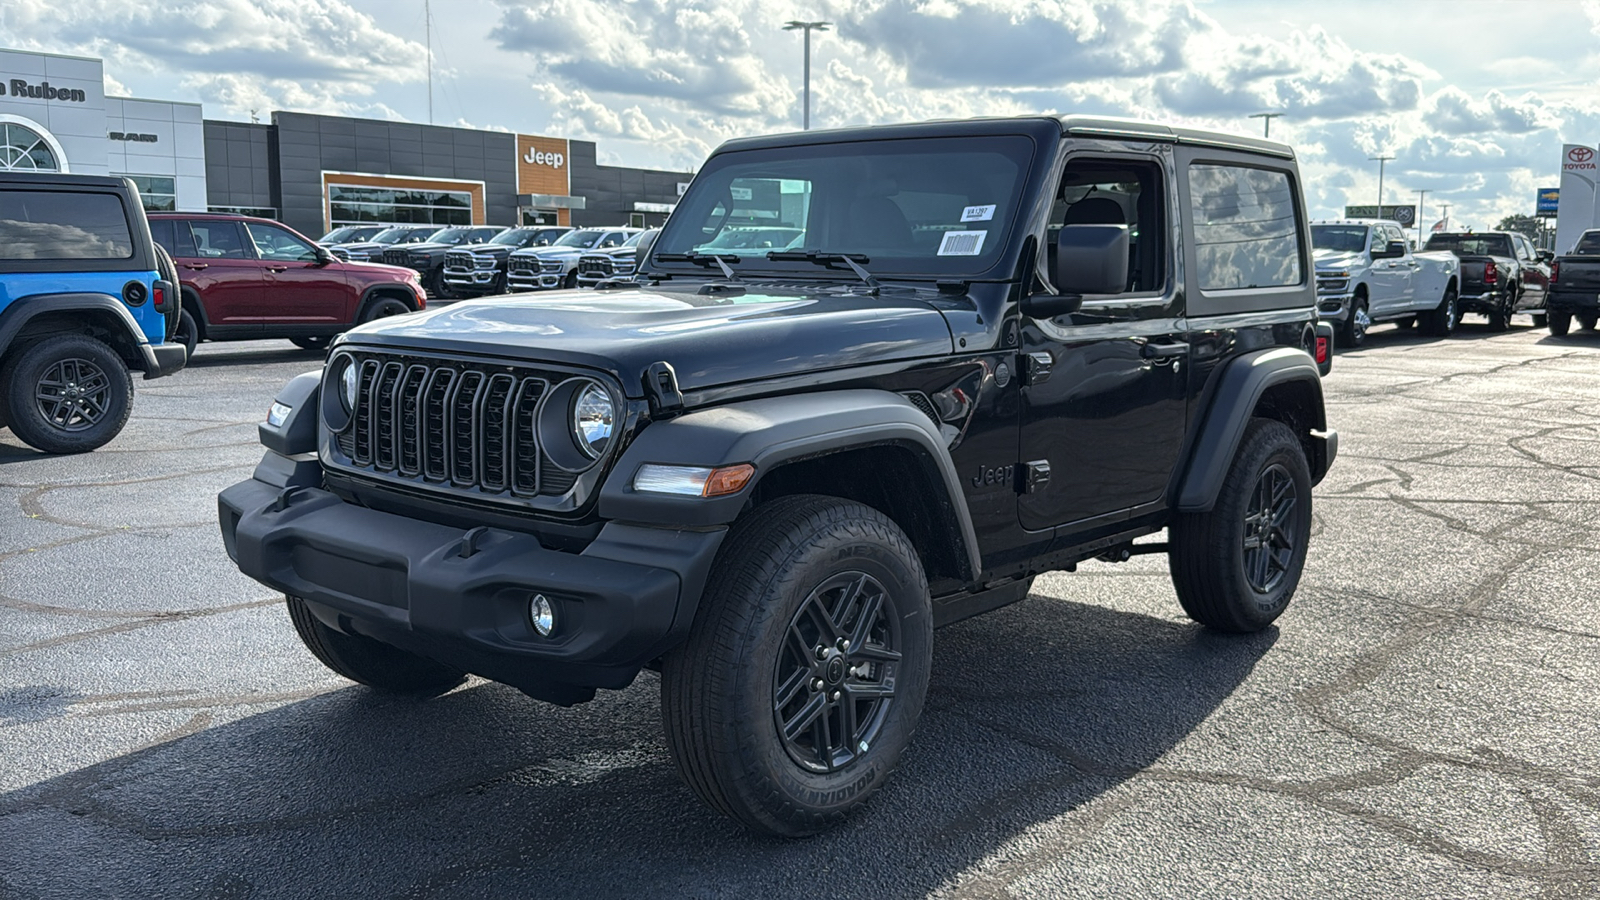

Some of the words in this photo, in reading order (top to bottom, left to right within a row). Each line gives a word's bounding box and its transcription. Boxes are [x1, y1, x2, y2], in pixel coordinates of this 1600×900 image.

[10, 78, 86, 102] Ruben
[523, 146, 564, 169] Jeep
[971, 464, 1014, 488] Jeep
